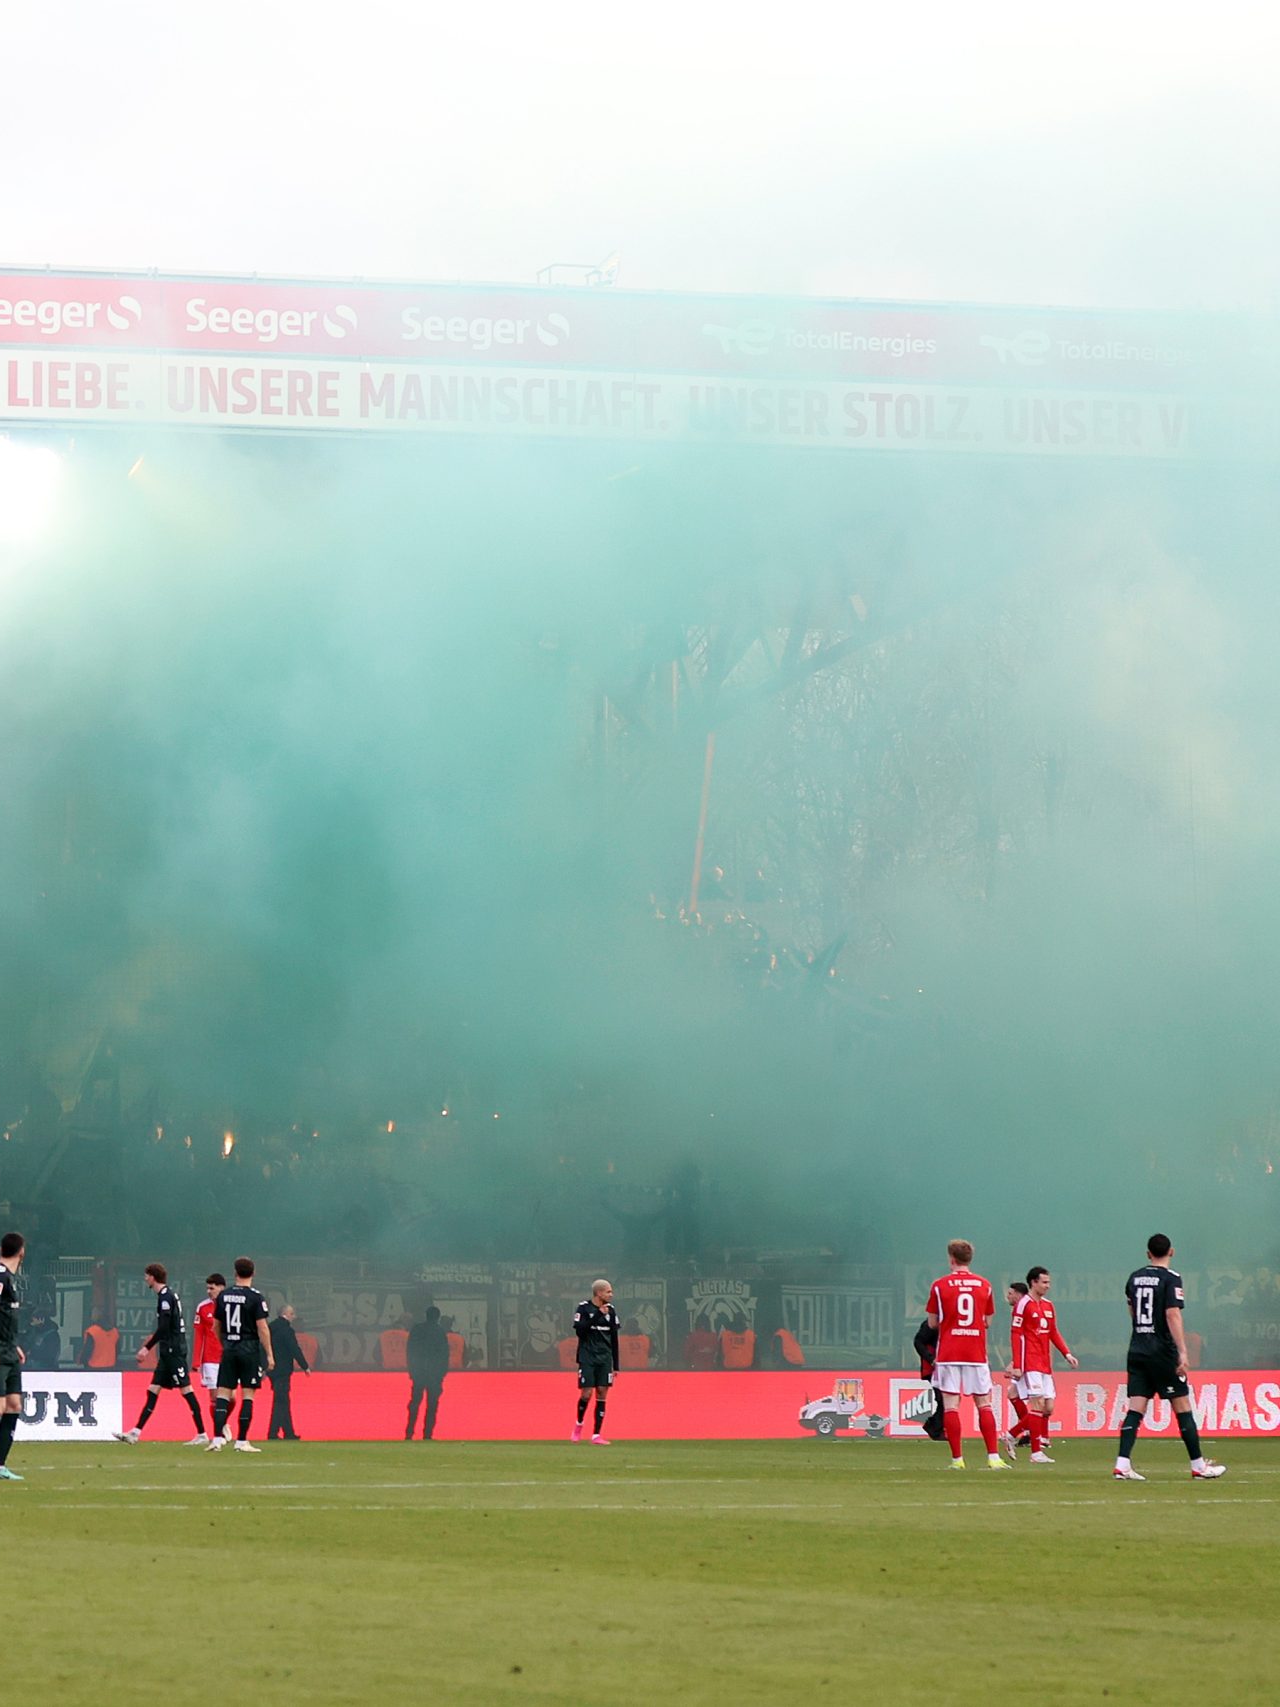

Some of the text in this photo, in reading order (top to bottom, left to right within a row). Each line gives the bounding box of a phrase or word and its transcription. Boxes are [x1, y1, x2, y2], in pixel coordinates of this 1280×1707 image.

[185, 298, 318, 342] Seeger
[400, 307, 532, 349] Seeger
[782, 328, 937, 357] TotalEnergies
[7, 360, 146, 412] LIEBE.
[165, 365, 341, 420] UNSERE
[359, 373, 671, 431] MANNSCHAFT.
[689, 385, 830, 437] UNSER
[844, 392, 985, 443] STOLZ.
[1003, 400, 1144, 449] UNSER
[223, 1295, 246, 1304] WERDER
[698, 1280, 744, 1295] ULTRAS
[225, 1303, 242, 1334] 14
[957, 1293, 974, 1327] 9
[1135, 1287, 1154, 1325] 13
[901, 1389, 934, 1419] HKL
